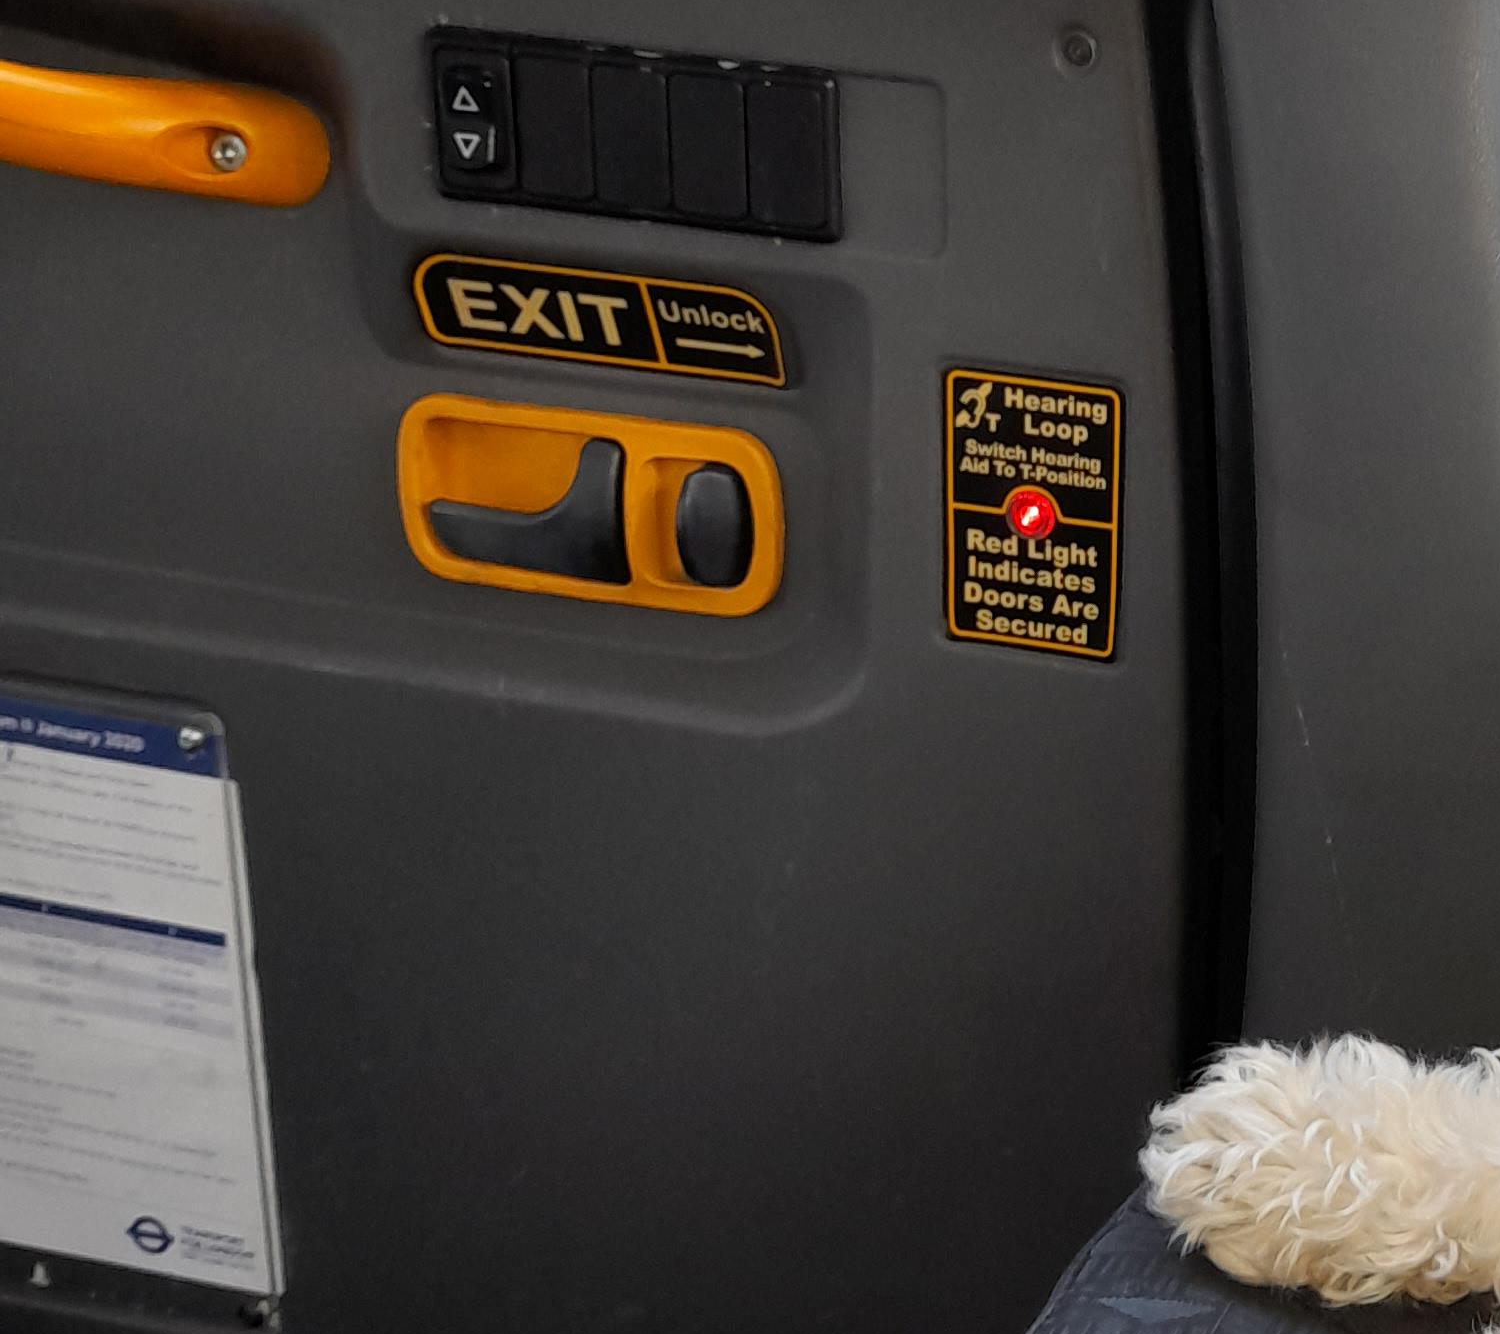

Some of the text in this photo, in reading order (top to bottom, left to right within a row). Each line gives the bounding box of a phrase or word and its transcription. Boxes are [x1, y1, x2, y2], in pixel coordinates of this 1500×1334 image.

[446, 277, 628, 346] EXIT
[657, 298, 765, 334] Unlock
[1004, 386, 1107, 424] Hearing
[1024, 414, 1088, 446] Loop
[960, 456, 1106, 490] Aid To T-Position
[965, 438, 1101, 475] Switch Hearing
[966, 528, 1098, 567] Red Light
[968, 555, 1096, 594] Indicates
[964, 581, 1099, 620] Doors Are
[975, 609, 1088, 645] Secured
